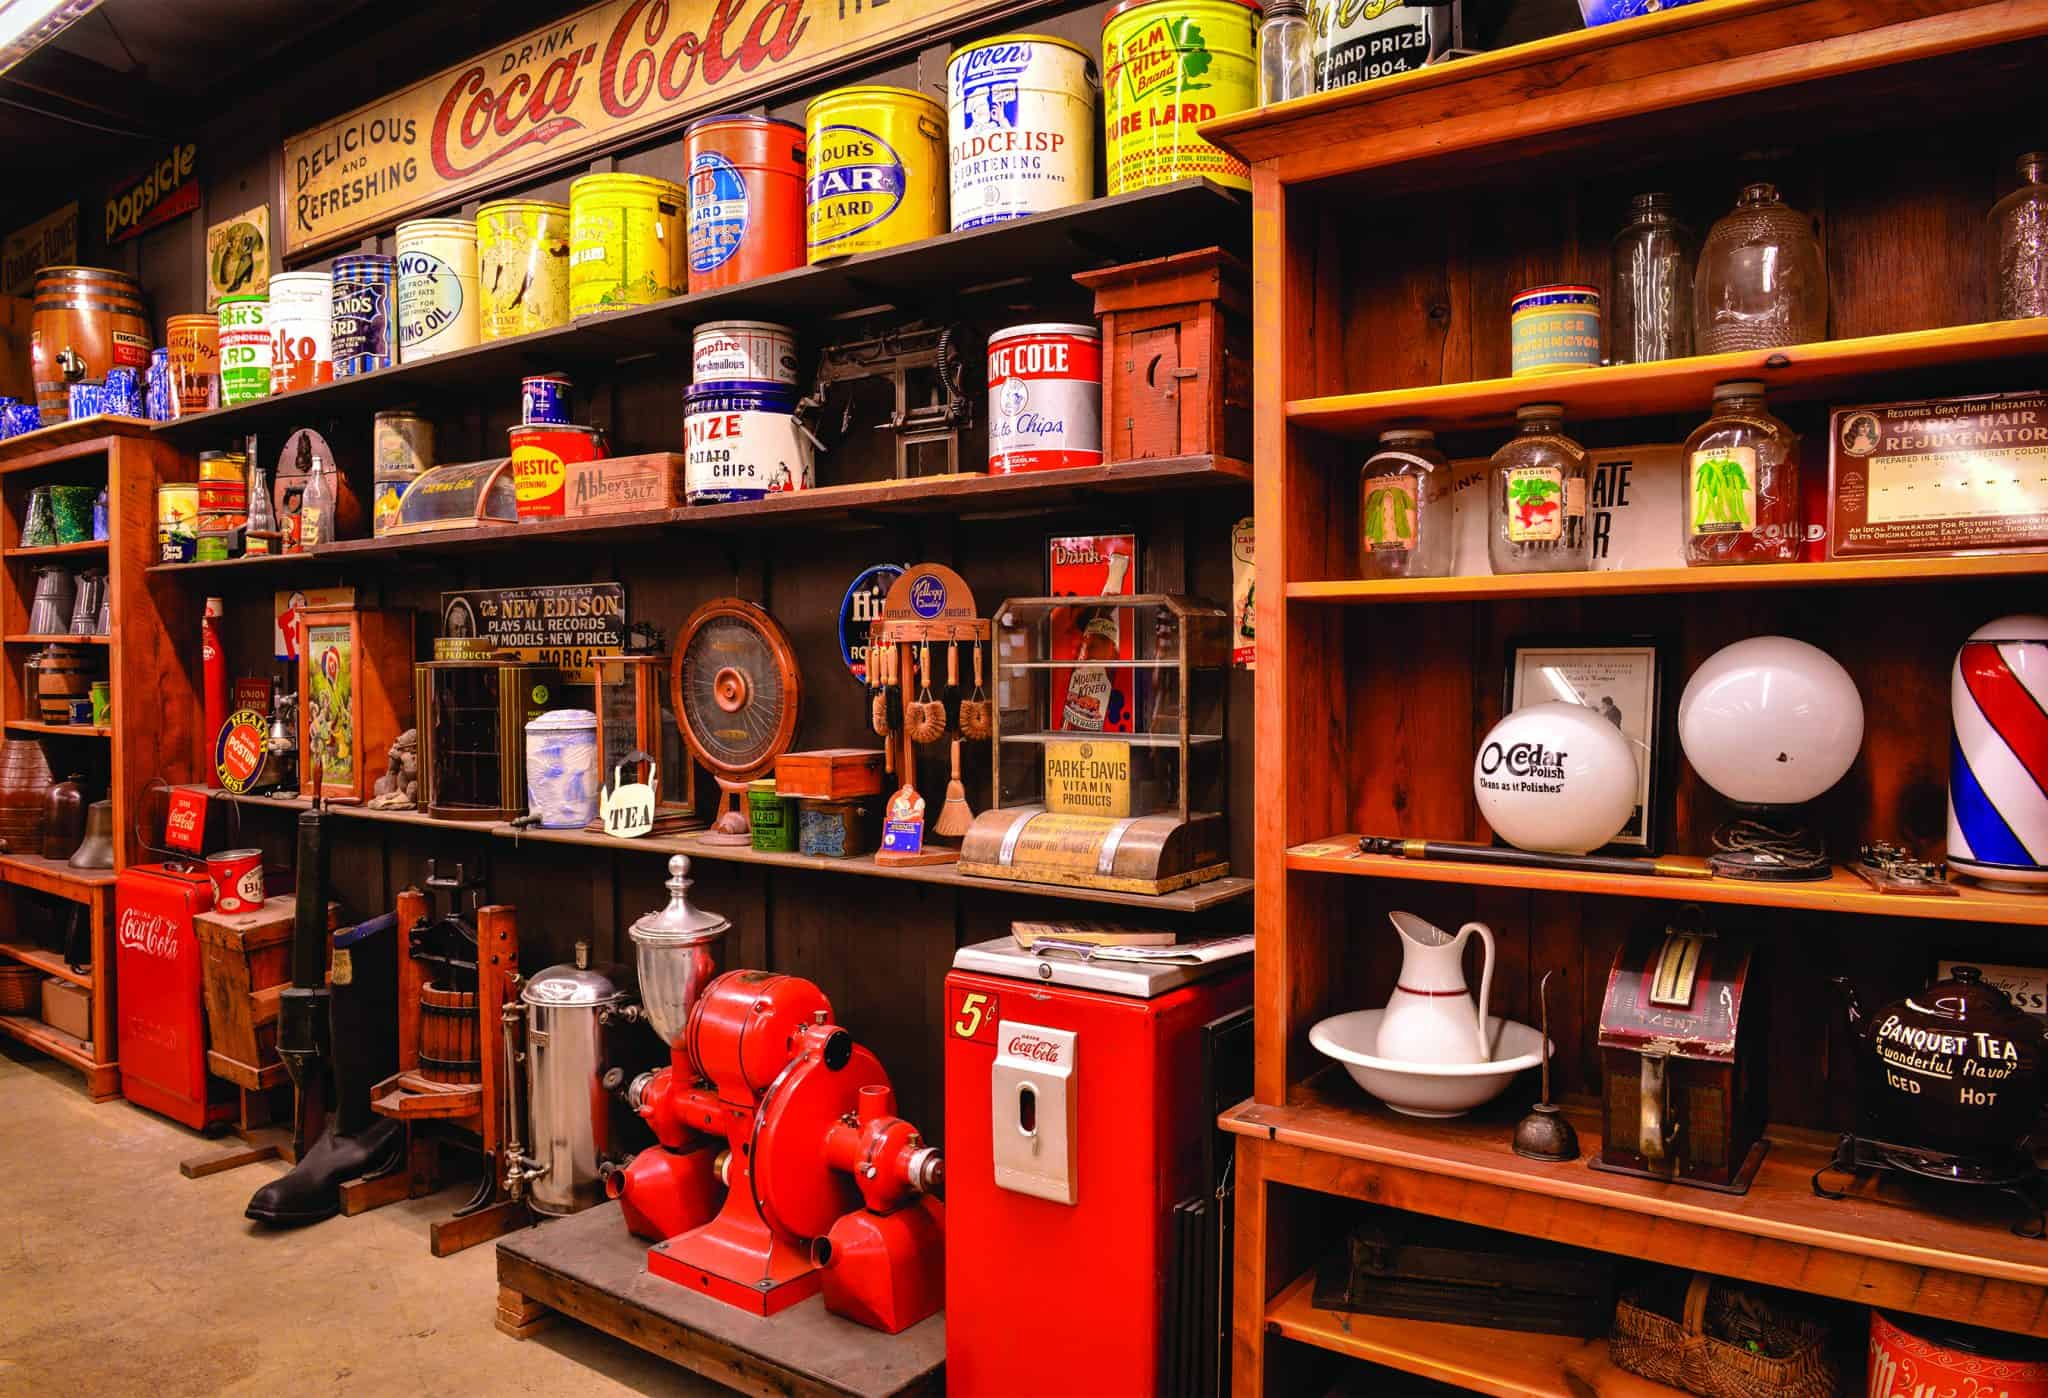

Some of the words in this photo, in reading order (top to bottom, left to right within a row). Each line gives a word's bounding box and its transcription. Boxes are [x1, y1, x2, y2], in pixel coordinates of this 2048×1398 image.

[501, 23, 576, 75] DRINK
[1127, 26, 1164, 57] ELM
[1131, 49, 1172, 79] HILL
[1318, 45, 1366, 75] GRAND
[1370, 32, 1426, 57] PRIZE
[1136, 62, 1175, 93] Brand
[1364, 57, 1413, 79] 1904.
[1149, 103, 1217, 128] LARD
[297, 118, 417, 193] DELICIOUS
[951, 131, 1065, 167] OLDCRISP
[341, 157, 367, 176] AND
[807, 166, 882, 198] TAR
[104, 143, 196, 245] popsicle
[297, 157, 418, 232] REFRESHING
[826, 200, 874, 219] LARD
[219, 306, 264, 327] BER'S
[332, 296, 373, 317] LAND'S
[401, 320, 424, 345] KING
[425, 307, 453, 330] OIL
[696, 340, 741, 361] ampfire
[989, 347, 1011, 383] ING
[1014, 343, 1070, 374] COLE
[179, 386, 209, 398] LARD
[1887, 408, 1932, 419] RESTORES
[1935, 404, 1961, 416] GRAY
[1963, 402, 1988, 413] HAIR
[1979, 410, 2038, 428] HAIR
[1016, 412, 1065, 437] Chips
[1886, 426, 2048, 452] REJUVENATOR
[513, 459, 561, 476] MESTIC
[713, 463, 756, 477] CHIPS
[1875, 456, 1923, 466] PREPARED
[1887, 523, 1939, 532] PREPARATION
[1056, 546, 1104, 567] Drink
[500, 591, 526, 599] CALL
[530, 588, 555, 598] AND
[558, 587, 594, 596] HEAR
[502, 600, 541, 619] NEW
[543, 596, 619, 618] EDISON
[488, 619, 521, 633] PLAYS
[524, 618, 544, 632] ALL
[548, 617, 606, 631] RECORDS
[577, 631, 619, 645] PRICES
[240, 689, 266, 700] UNION
[231, 711, 269, 754] HEALTH
[227, 735, 257, 767] POSTUM
[218, 764, 245, 793] FIRST
[1048, 759, 1127, 780] PARKE-DAVIS
[1529, 766, 1565, 779] Polish
[1062, 780, 1112, 793] VITAMIN
[1501, 782, 1511, 791] as
[1062, 793, 1112, 807] PRODUCTS
[610, 804, 651, 830] TEA
[119, 907, 179, 958] Coca-Cola
[1008, 1036, 1062, 1063] Coca-Cola
[1879, 1015, 1969, 1057] BANQUET
[1972, 1031, 2019, 1061] TEA
[1884, 1048, 1954, 1075] wonderful
[1886, 1068, 1921, 1095] ICED
[1960, 1087, 1998, 1106] HOT
